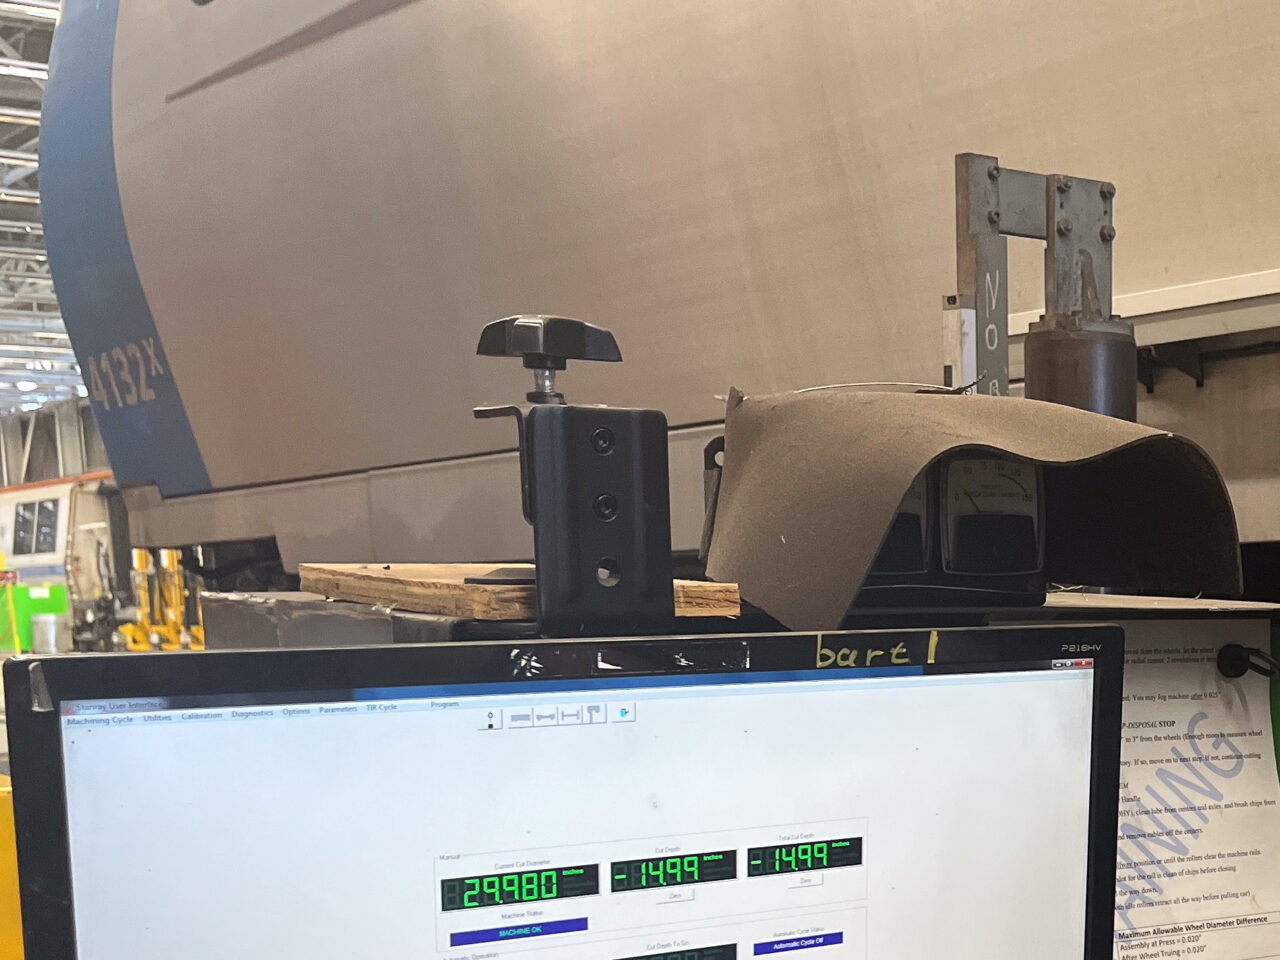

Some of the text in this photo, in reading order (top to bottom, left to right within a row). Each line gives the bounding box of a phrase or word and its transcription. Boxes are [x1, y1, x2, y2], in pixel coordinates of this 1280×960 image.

[816, 634, 911, 668] bart
[67, 717, 109, 726] Machining
[112, 715, 133, 724] Cycle
[144, 714, 171, 722] Utilities
[182, 712, 222, 720] Calibration
[231, 709, 274, 720] Diagnostics
[283, 708, 310, 716] Options
[379, 703, 397, 712] Cycle
[431, 701, 459, 709] Program
[464, 871, 557, 907] 29.980
[499, 927, 530, 936] MACHINE
[1118, 916, 1268, 940] Maximum Allowable Wheel Diameter Difference
[774, 940, 799, 950] Automatic
[1120, 941, 1150, 951] Assembly
[1159, 938, 1176, 947] Press
[1139, 950, 1160, 960] Wheel
[1161, 948, 1181, 958] Truing
